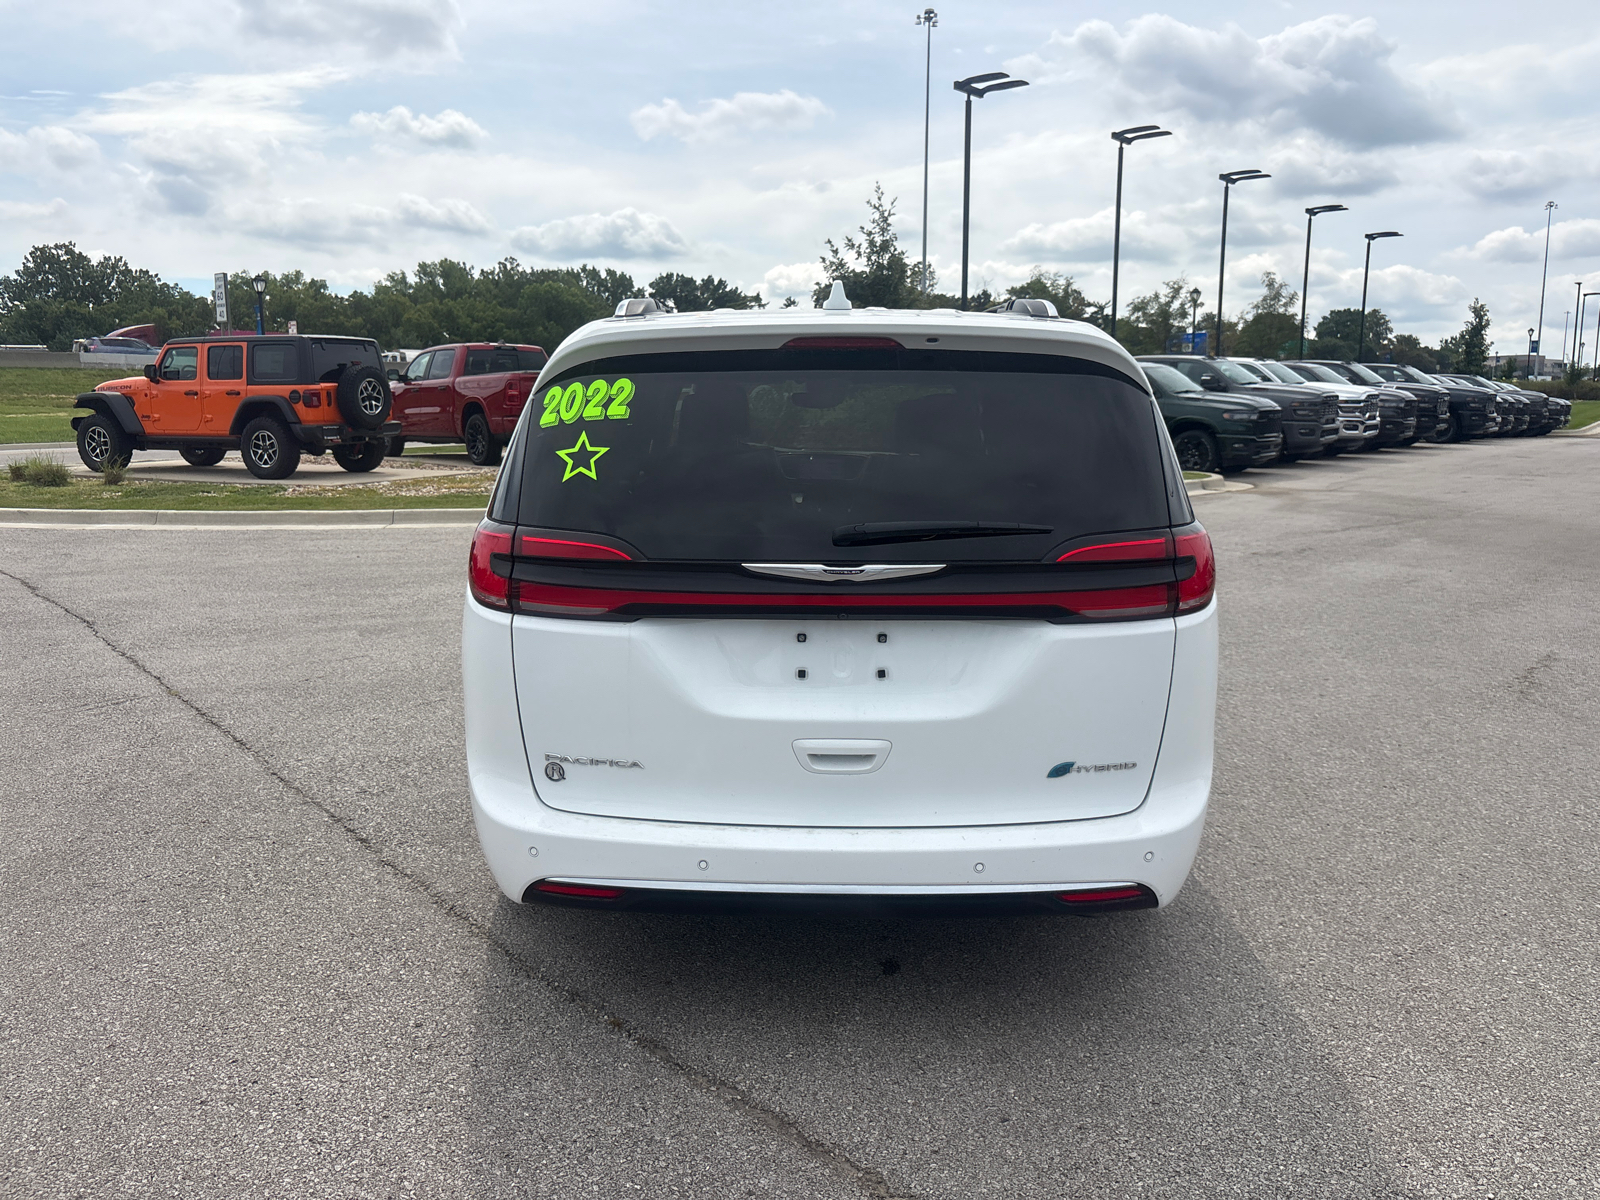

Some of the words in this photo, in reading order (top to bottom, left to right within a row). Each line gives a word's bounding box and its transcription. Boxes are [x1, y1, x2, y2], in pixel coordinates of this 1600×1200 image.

[217, 292, 224, 301] 60
[219, 310, 225, 319] 40
[97, 384, 132, 392] RUBICON
[539, 377, 636, 429] 2022
[544, 752, 645, 769] PACIFICA
[1070, 761, 1137, 773] HYBRID
